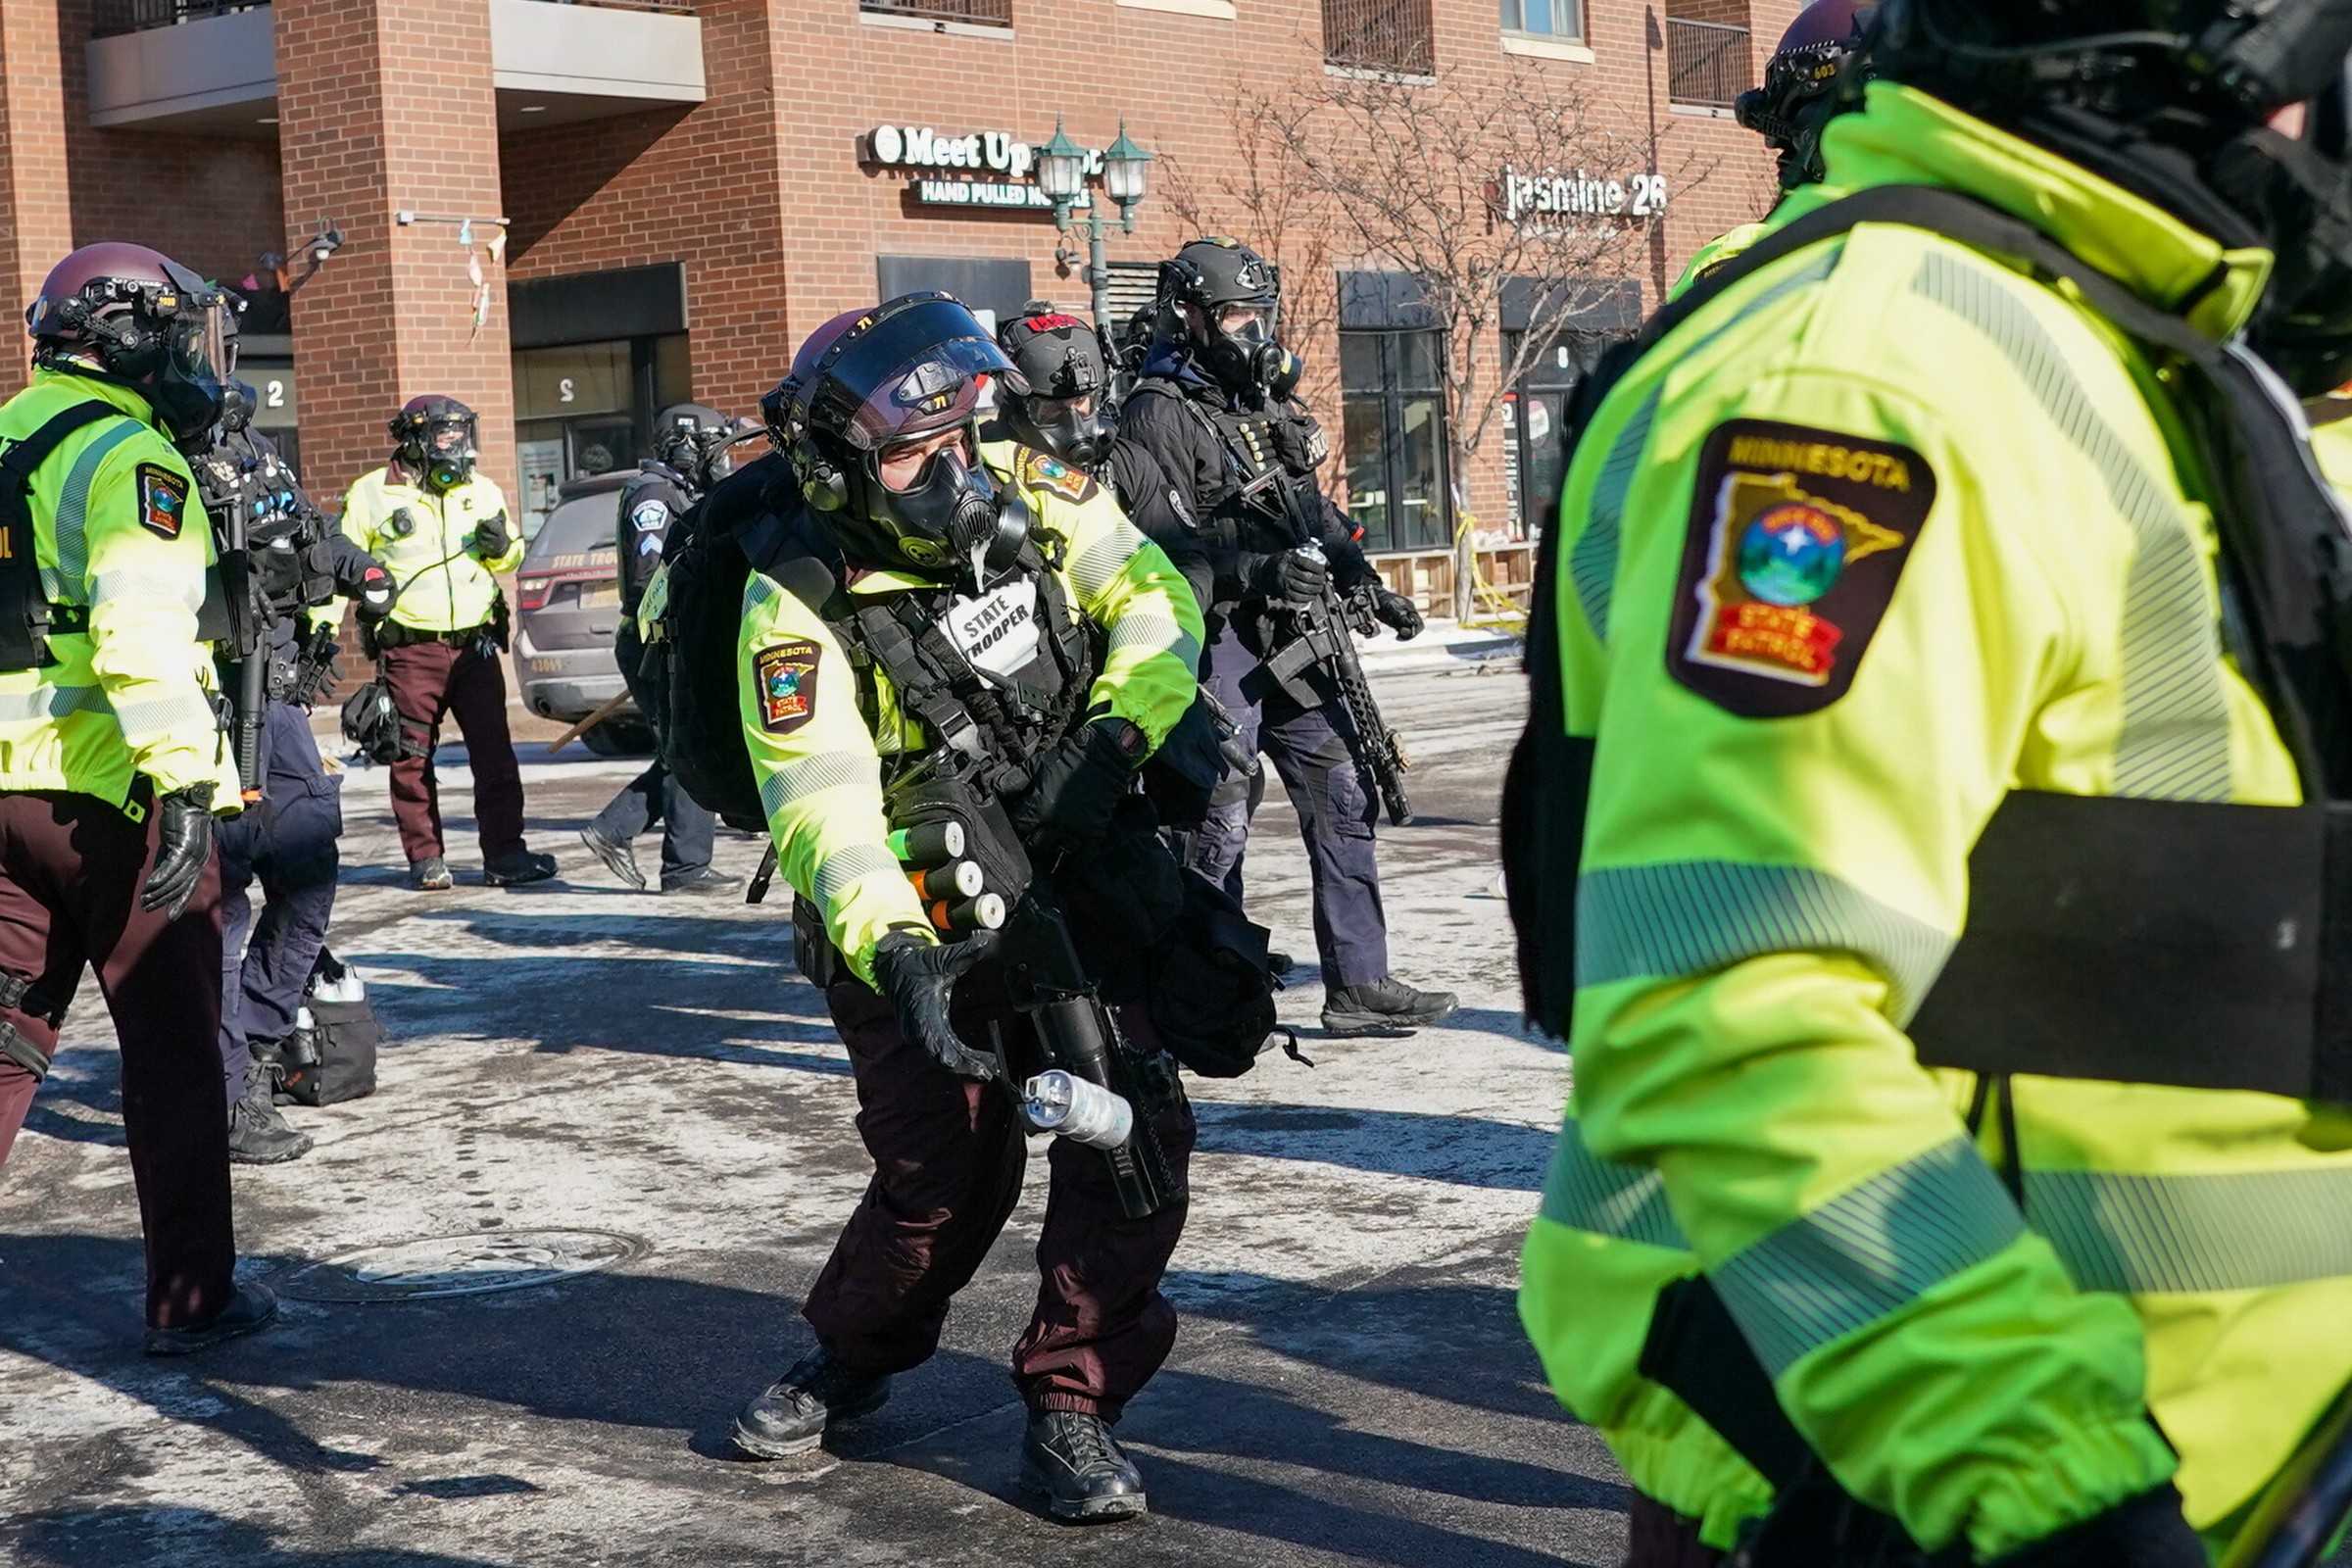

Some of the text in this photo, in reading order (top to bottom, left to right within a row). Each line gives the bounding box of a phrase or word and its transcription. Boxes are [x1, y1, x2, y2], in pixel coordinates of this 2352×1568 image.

[1813, 64, 1837, 79] 603
[905, 126, 982, 166] Meet
[984, 130, 1032, 178] Up
[921, 180, 970, 203] HAND
[971, 183, 1026, 206] PULLED
[1632, 173, 1667, 217] 26
[857, 316, 873, 331] 71
[268, 379, 284, 407] 2
[934, 394, 947, 410] 71
[1728, 435, 1912, 491] MINNESOTA
[552, 551, 618, 569] STATE TRO
[963, 595, 1009, 638] STATE
[1739, 603, 1817, 639] STATE
[760, 646, 813, 664] MINNESOTA
[775, 705, 803, 717] PATROL
[776, 695, 798, 709] STATE
